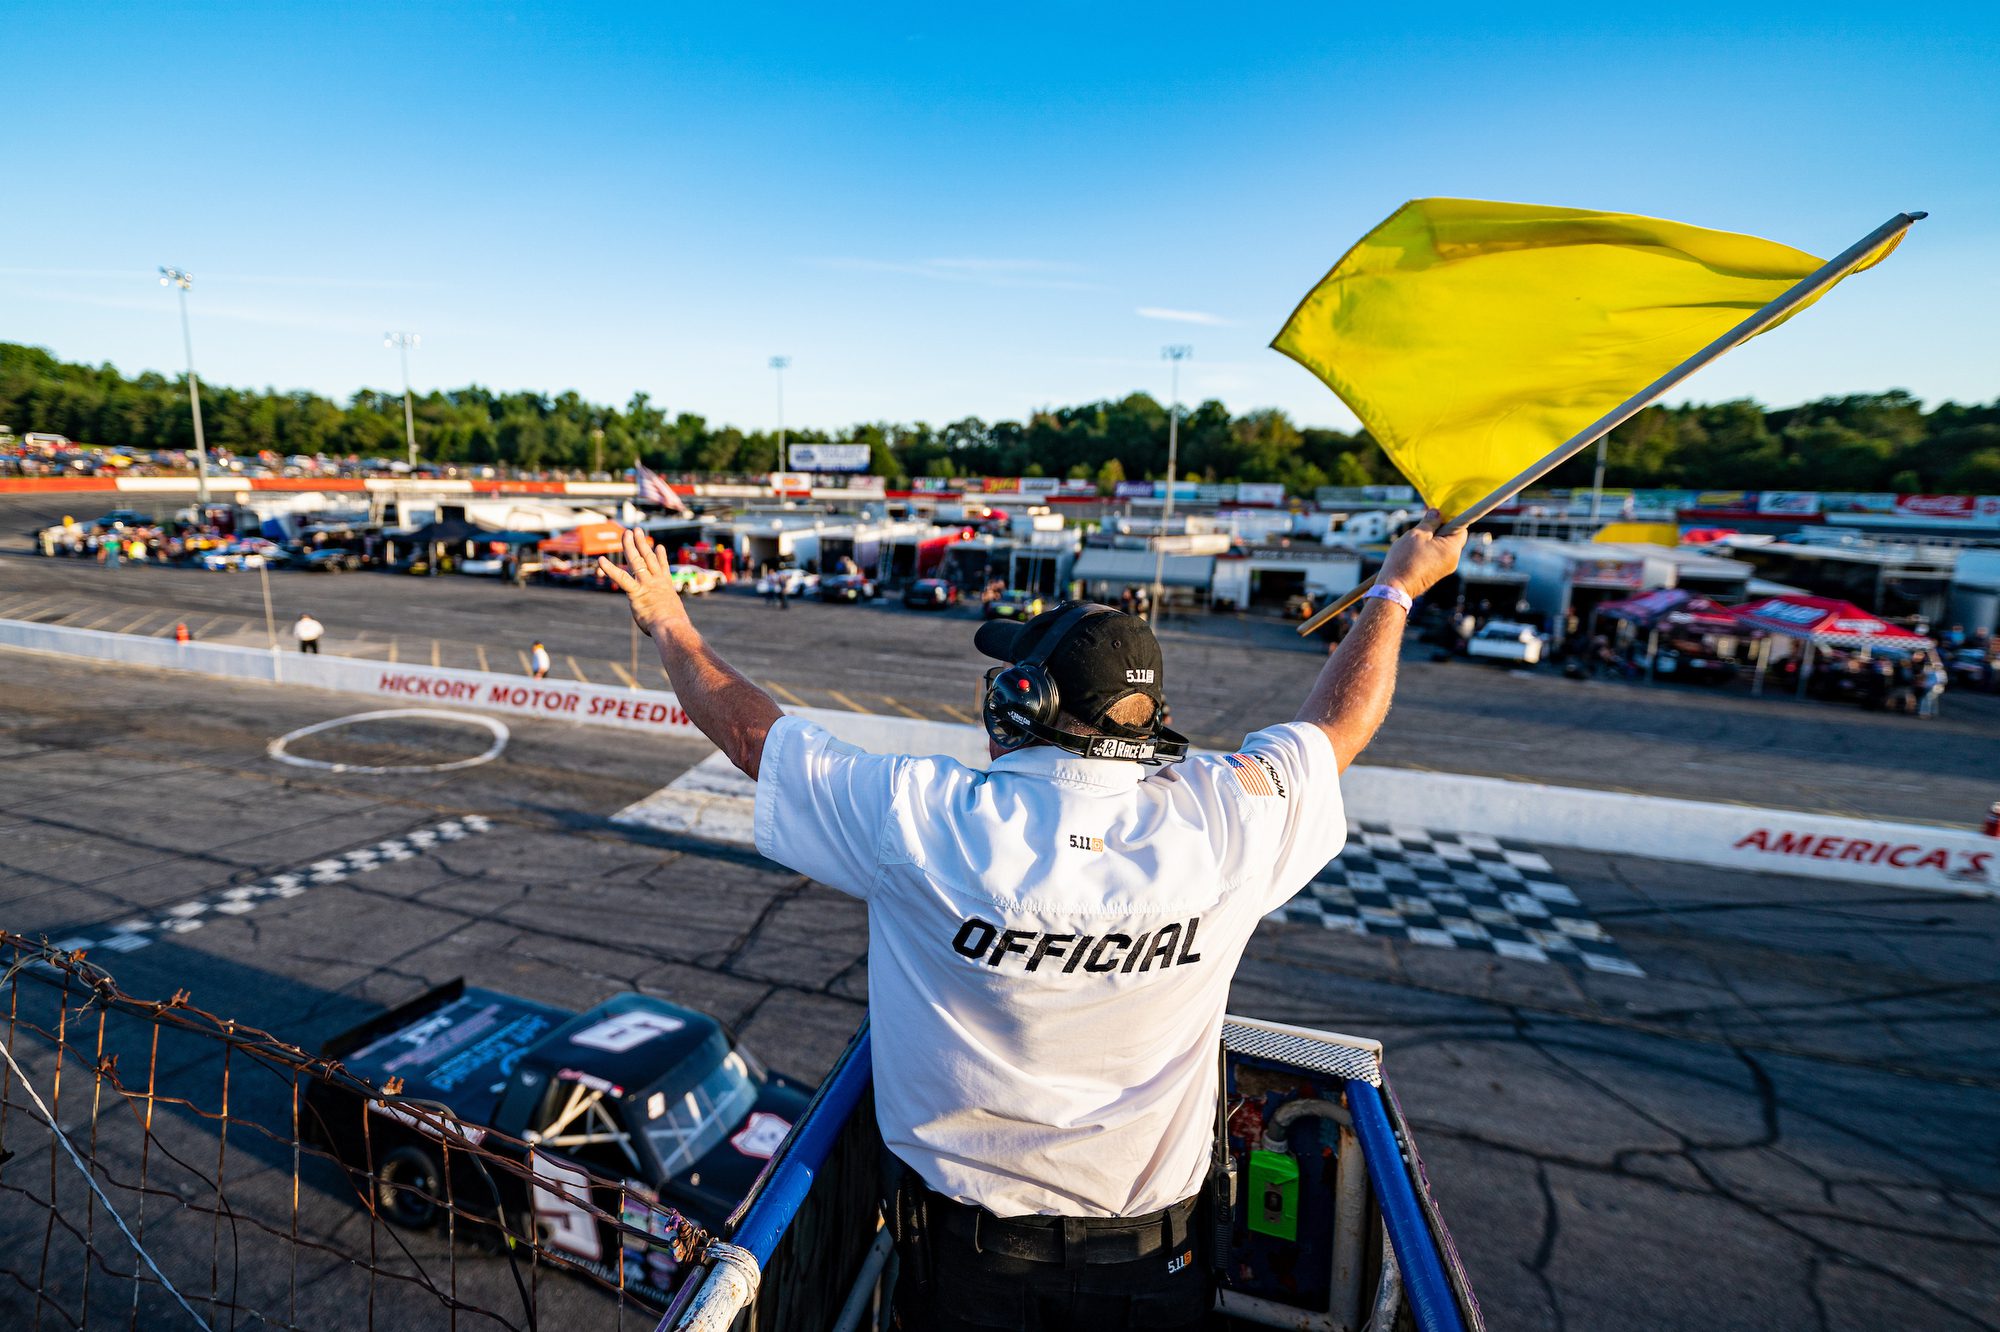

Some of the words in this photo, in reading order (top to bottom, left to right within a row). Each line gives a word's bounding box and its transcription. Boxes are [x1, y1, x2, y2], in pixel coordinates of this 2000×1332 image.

[1126, 669, 1147, 683] 5.11
[379, 671, 480, 701] HICKORY
[488, 685, 580, 713] MOTOR
[587, 696, 691, 727] SPEEDW
[1116, 741, 1140, 758] RACE
[1069, 834, 1091, 851] 5.11
[1733, 828, 1994, 882] AMERICA'S
[951, 917, 1201, 973] OFFICIAL
[1167, 1255, 1185, 1274] 5.11
